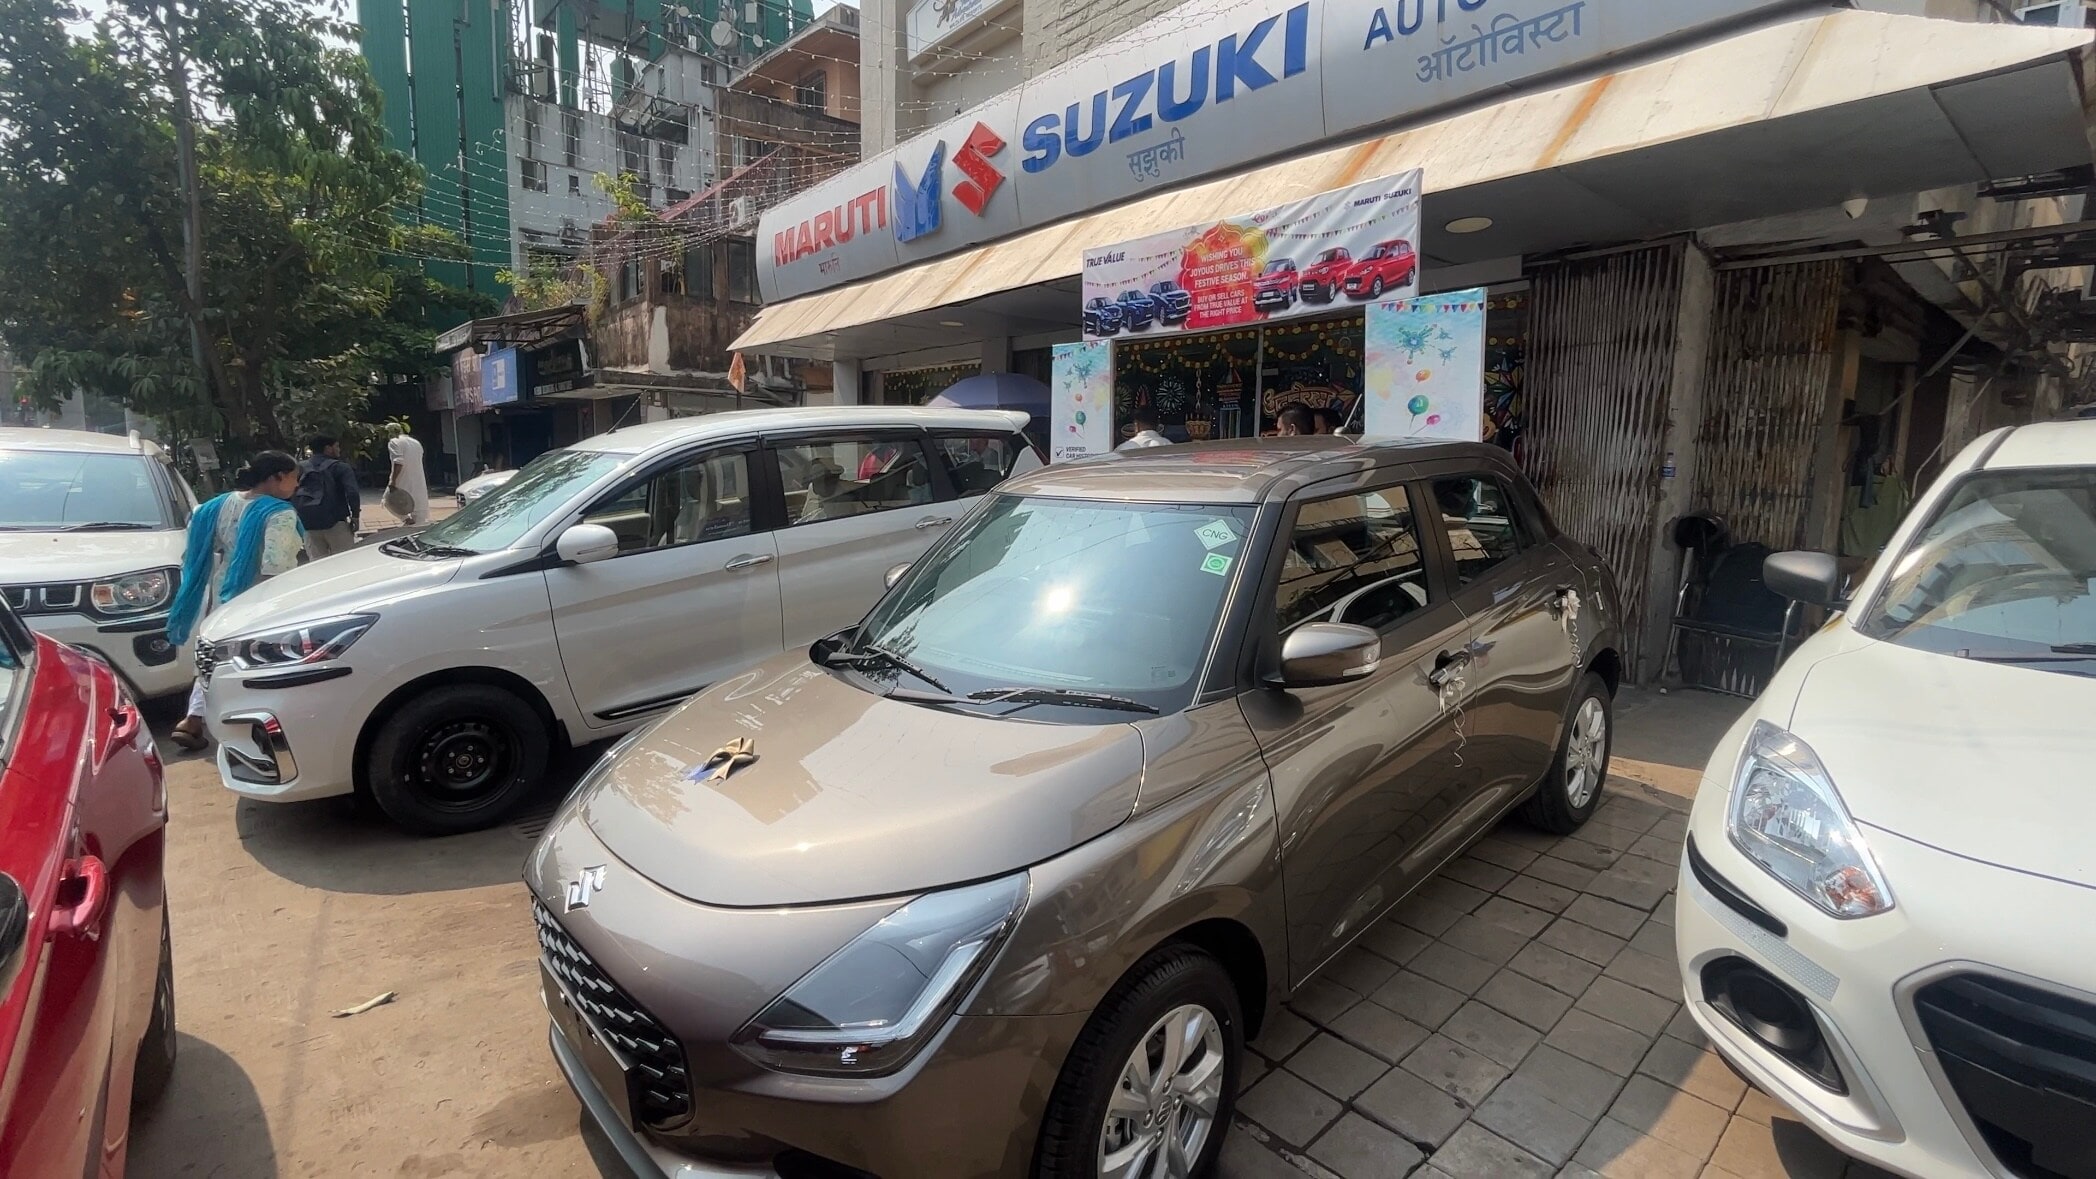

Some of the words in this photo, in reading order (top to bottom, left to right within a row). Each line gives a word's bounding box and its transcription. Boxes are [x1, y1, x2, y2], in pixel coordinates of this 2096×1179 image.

[1363, 0, 1487, 50] AU
[1416, 1, 1585, 83] ऑटोविस्टा
[775, 185, 886, 267] MARUTI
[1022, 2, 1309, 173] SUZUKI
[1127, 127, 1185, 182] सुझुकी
[1353, 195, 1381, 207] MARUTI
[1384, 188, 1412, 199] SUZUKI
[1201, 250, 1228, 262] WISHING
[1229, 247, 1243, 257] YOU
[1189, 265, 1214, 277] JOYOUS
[1215, 260, 1239, 272] DRIVES
[1240, 257, 1255, 267] THIS
[1194, 276, 1219, 288] FESTIVE
[1194, 302, 1209, 311] FROM
[1209, 300, 1223, 309] TRUE
[1223, 298, 1240, 308] VALUE
[1241, 296, 1248, 305] AT
[1197, 294, 1207, 303] BUY
[1208, 293, 1216, 301] OR
[1217, 291, 1229, 300] SELL
[1230, 289, 1245, 298] CARS
[1199, 311, 1209, 319] THE
[1209, 308, 1225, 318] RIGHT
[1226, 306, 1242, 315] PRICE
[1202, 529, 1228, 540] CNG
